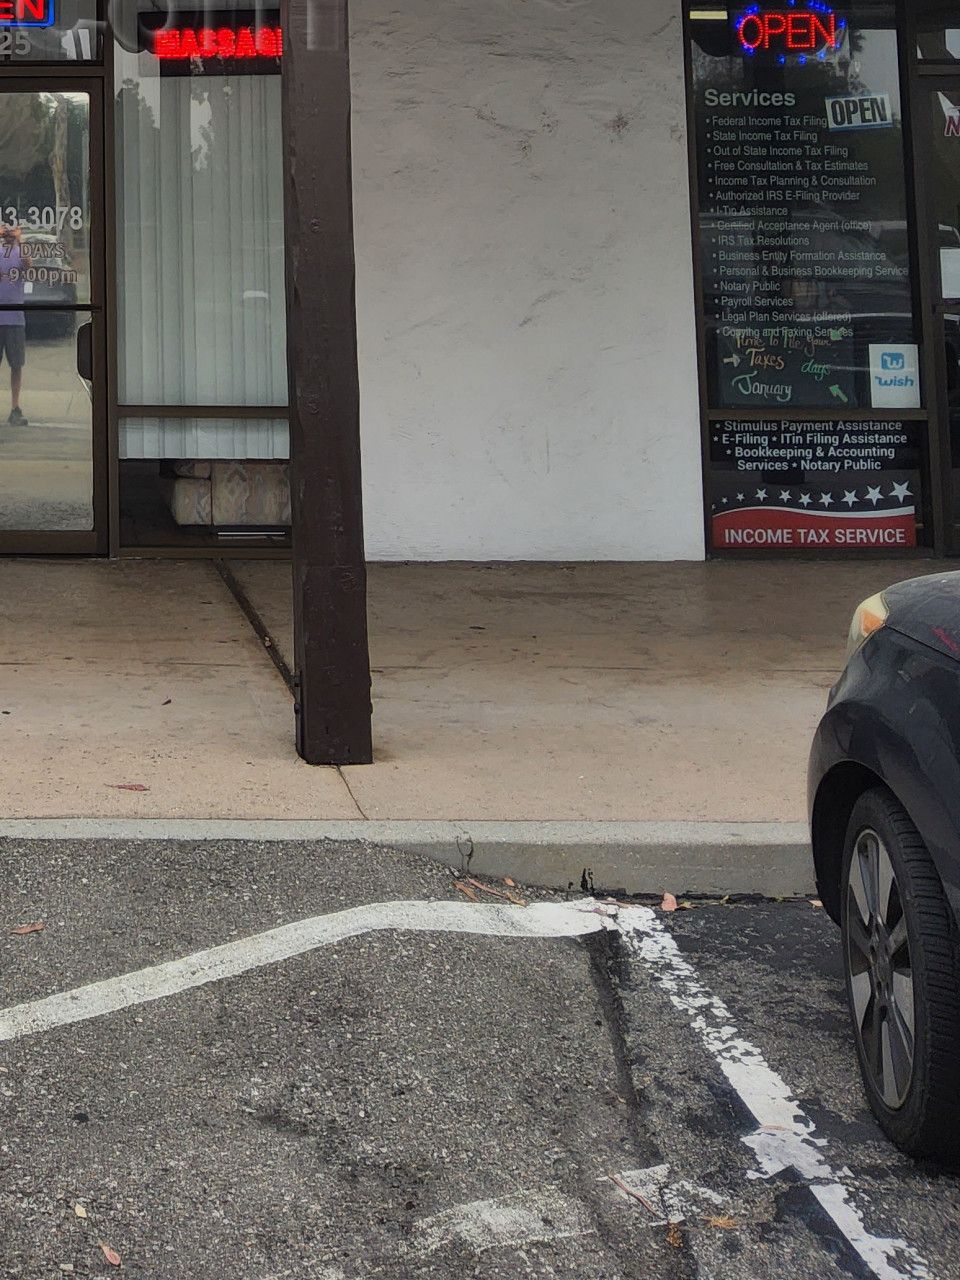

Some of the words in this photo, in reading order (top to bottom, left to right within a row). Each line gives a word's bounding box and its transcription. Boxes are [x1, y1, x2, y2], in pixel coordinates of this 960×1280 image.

[739, 13, 836, 49] OPEN
[704, 88, 796, 107] Services
[830, 97, 887, 126] OPEN
[712, 116, 746, 127] Federal
[748, 116, 781, 127] Income
[783, 116, 801, 127] Tax
[803, 116, 827, 129] Filing
[713, 131, 737, 142] State
[739, 131, 772, 142] Income
[774, 131, 791, 142] Tax
[793, 131, 818, 144] Filing
[713, 146, 731, 157] Out
[733, 146, 742, 157] of
[743, 146, 768, 157] State
[770, 146, 802, 157] Income
[804, 146, 822, 157] Tax
[824, 146, 848, 159] Filing
[714, 161, 735, 172] Free
[737, 161, 793, 172] Consultation
[795, 161, 803, 172] &
[805, 161, 822, 172] Tax
[824, 161, 869, 172] Estimates
[715, 176, 748, 187] Income
[750, 176, 768, 187] Tax
[770, 176, 809, 189] Planning
[811, 176, 818, 187] &
[820, 176, 876, 187] Consultation
[716, 191, 764, 202] Authorized
[766, 191, 783, 202] IRS
[785, 191, 820, 204] E-Filing
[821, 191, 861, 202] Provider
[739, 206, 788, 217] Assistance
[757, 221, 810, 234] Acceptance
[812, 221, 840, 234] Agent
[718, 236, 735, 247] IRS
[737, 236, 754, 247] Tax
[757, 236, 810, 247] Resolutions
[2, 242, 14, 259] 7
[20, 242, 66, 259] DAYS
[719, 251, 760, 262] Business
[762, 251, 788, 264] Entity
[790, 251, 836, 262] Formation
[837, 251, 886, 262] Assistance
[719, 266, 760, 277] Personal
[762, 266, 769, 277] &
[771, 266, 812, 277] Business
[814, 266, 873, 279] Bookkeeping
[720, 281, 751, 294] Notary
[753, 281, 781, 292] Public
[721, 296, 752, 309] Payroll
[754, 296, 793, 307] Services
[721, 311, 747, 324] Legal
[749, 311, 770, 322] Plan
[772, 311, 811, 322] Services
[745, 347, 785, 370] Taxes
[731, 370, 792, 402] January
[876, 376, 913, 387] wish
[724, 420, 778, 431] Stimulus
[781, 420, 834, 434] Payment
[837, 420, 902, 431] Assistance
[722, 434, 769, 447] E-Filing
[806, 433, 839, 447] Filing
[842, 433, 908, 444] Assistance
[735, 447, 813, 460] Bookkeeping
[816, 447, 825, 457] &
[828, 446, 895, 459] Accounting
[737, 460, 789, 471] Services
[800, 460, 841, 473] Notary
[844, 460, 882, 471] Public
[724, 528, 792, 544] INCOME
[797, 528, 831, 544] TAX
[835, 528, 906, 544] SERVICE
